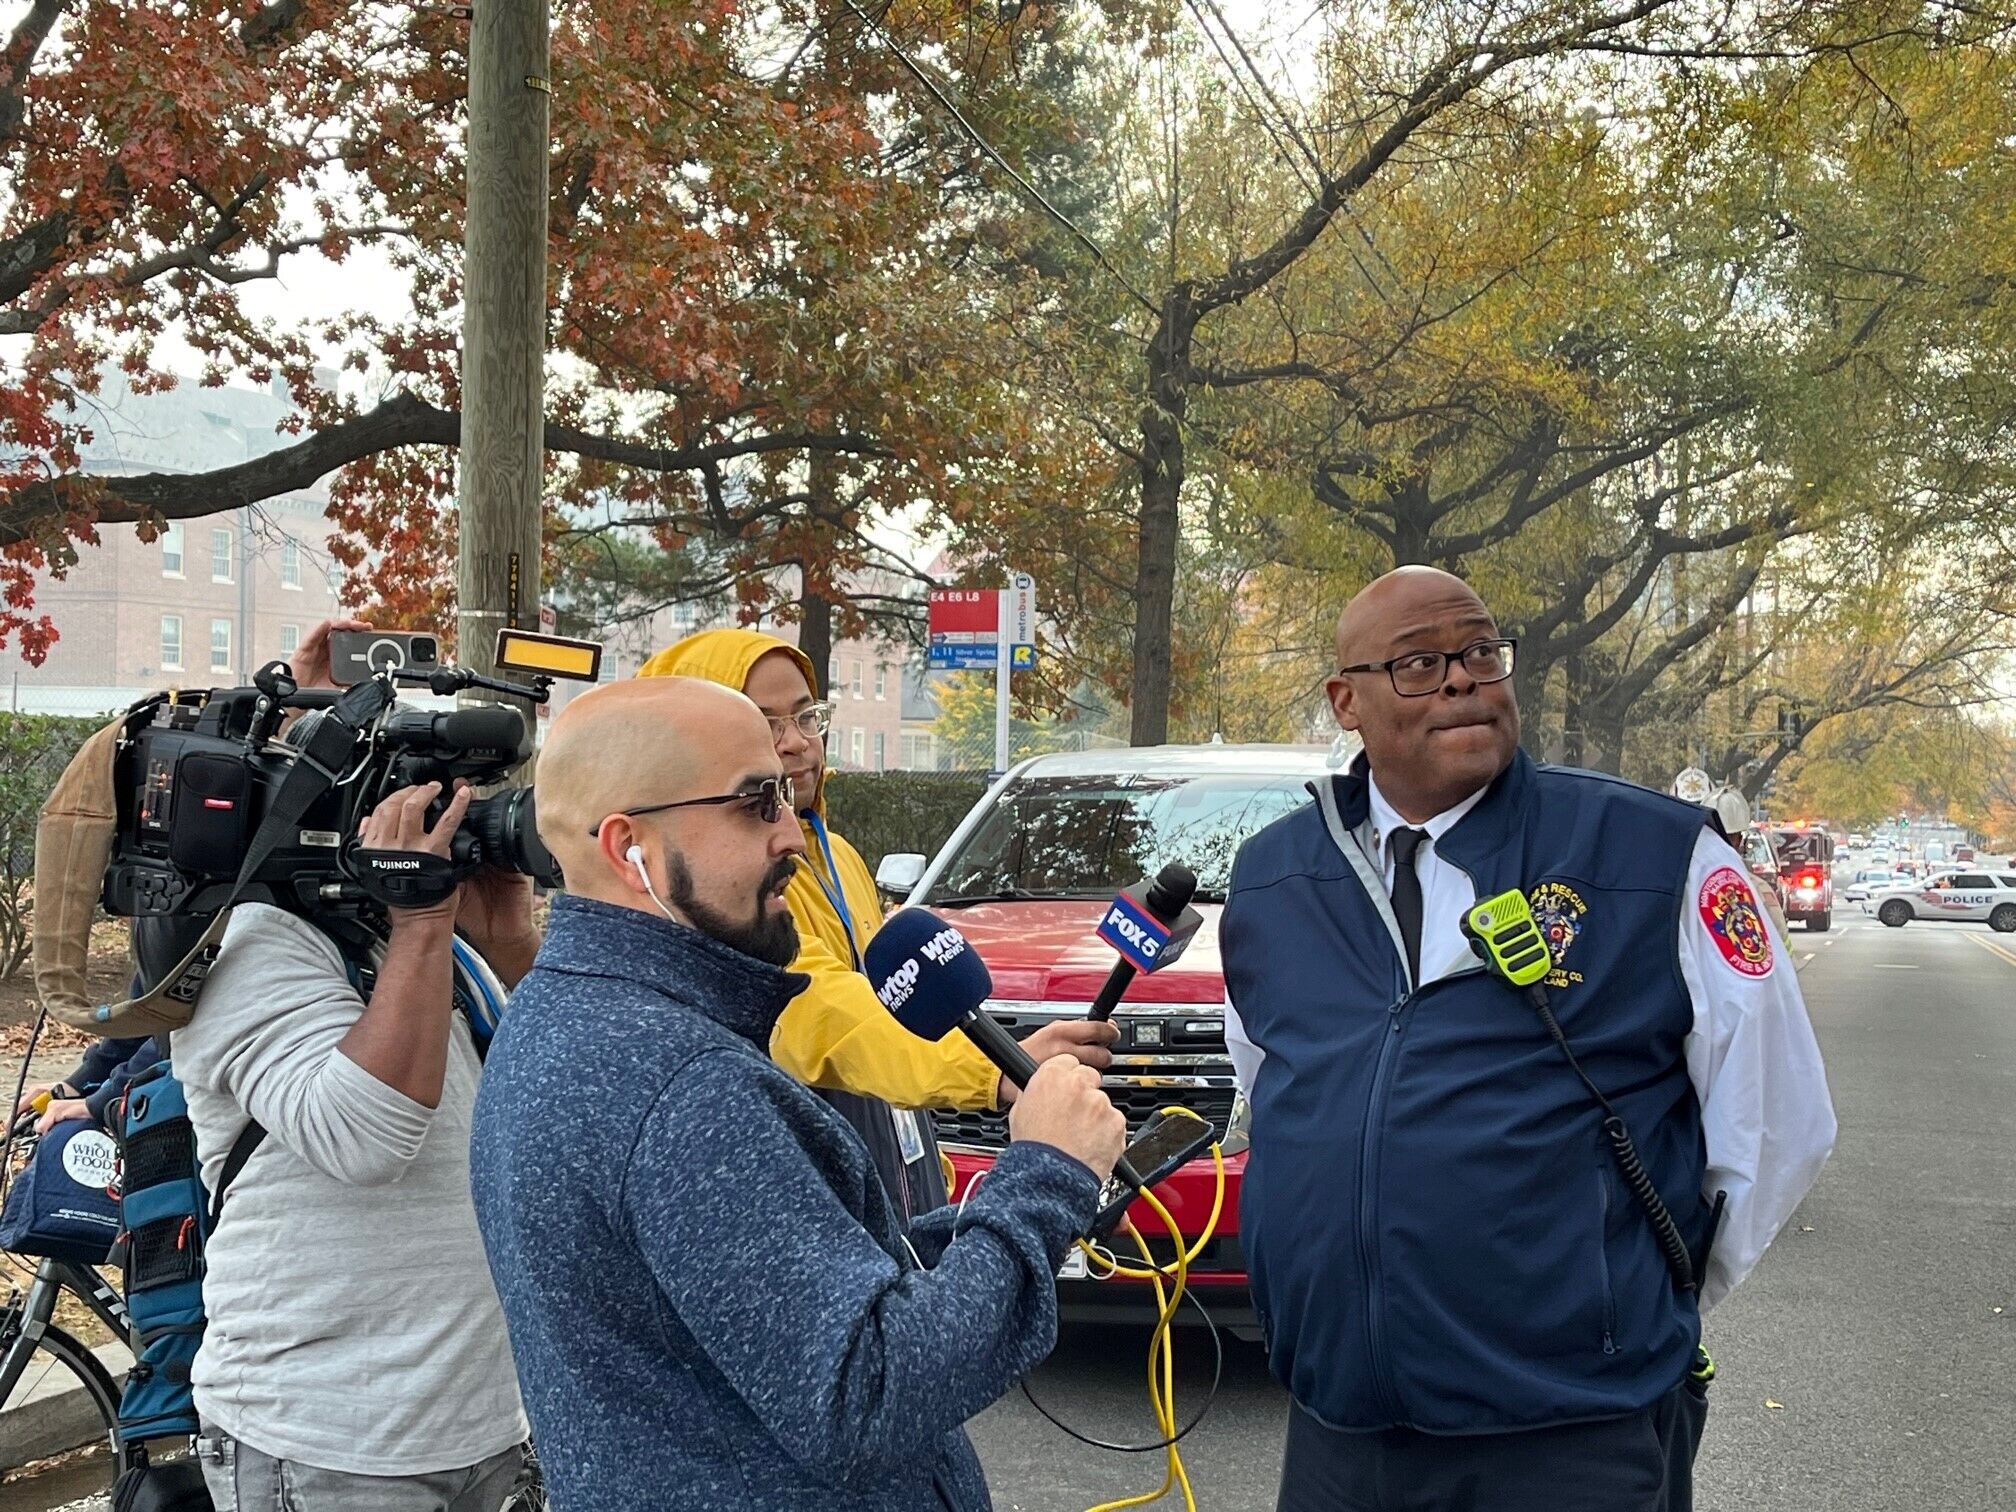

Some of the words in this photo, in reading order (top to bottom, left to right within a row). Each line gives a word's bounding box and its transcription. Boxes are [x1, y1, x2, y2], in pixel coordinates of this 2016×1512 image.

[931, 592, 944, 602] E4
[948, 592, 962, 602] E6
[1017, 592, 1026, 641] metrobus
[372, 860, 420, 870] FUJINON
[1551, 882, 1588, 914] RESCUE
[1943, 896, 1993, 904] POLICE
[1107, 907, 1147, 949] FOX
[920, 928, 965, 960] wtop
[937, 944, 965, 966] news
[877, 958, 920, 1006] wtop
[889, 984, 914, 1012] news
[73, 1143, 114, 1160] WHOL
